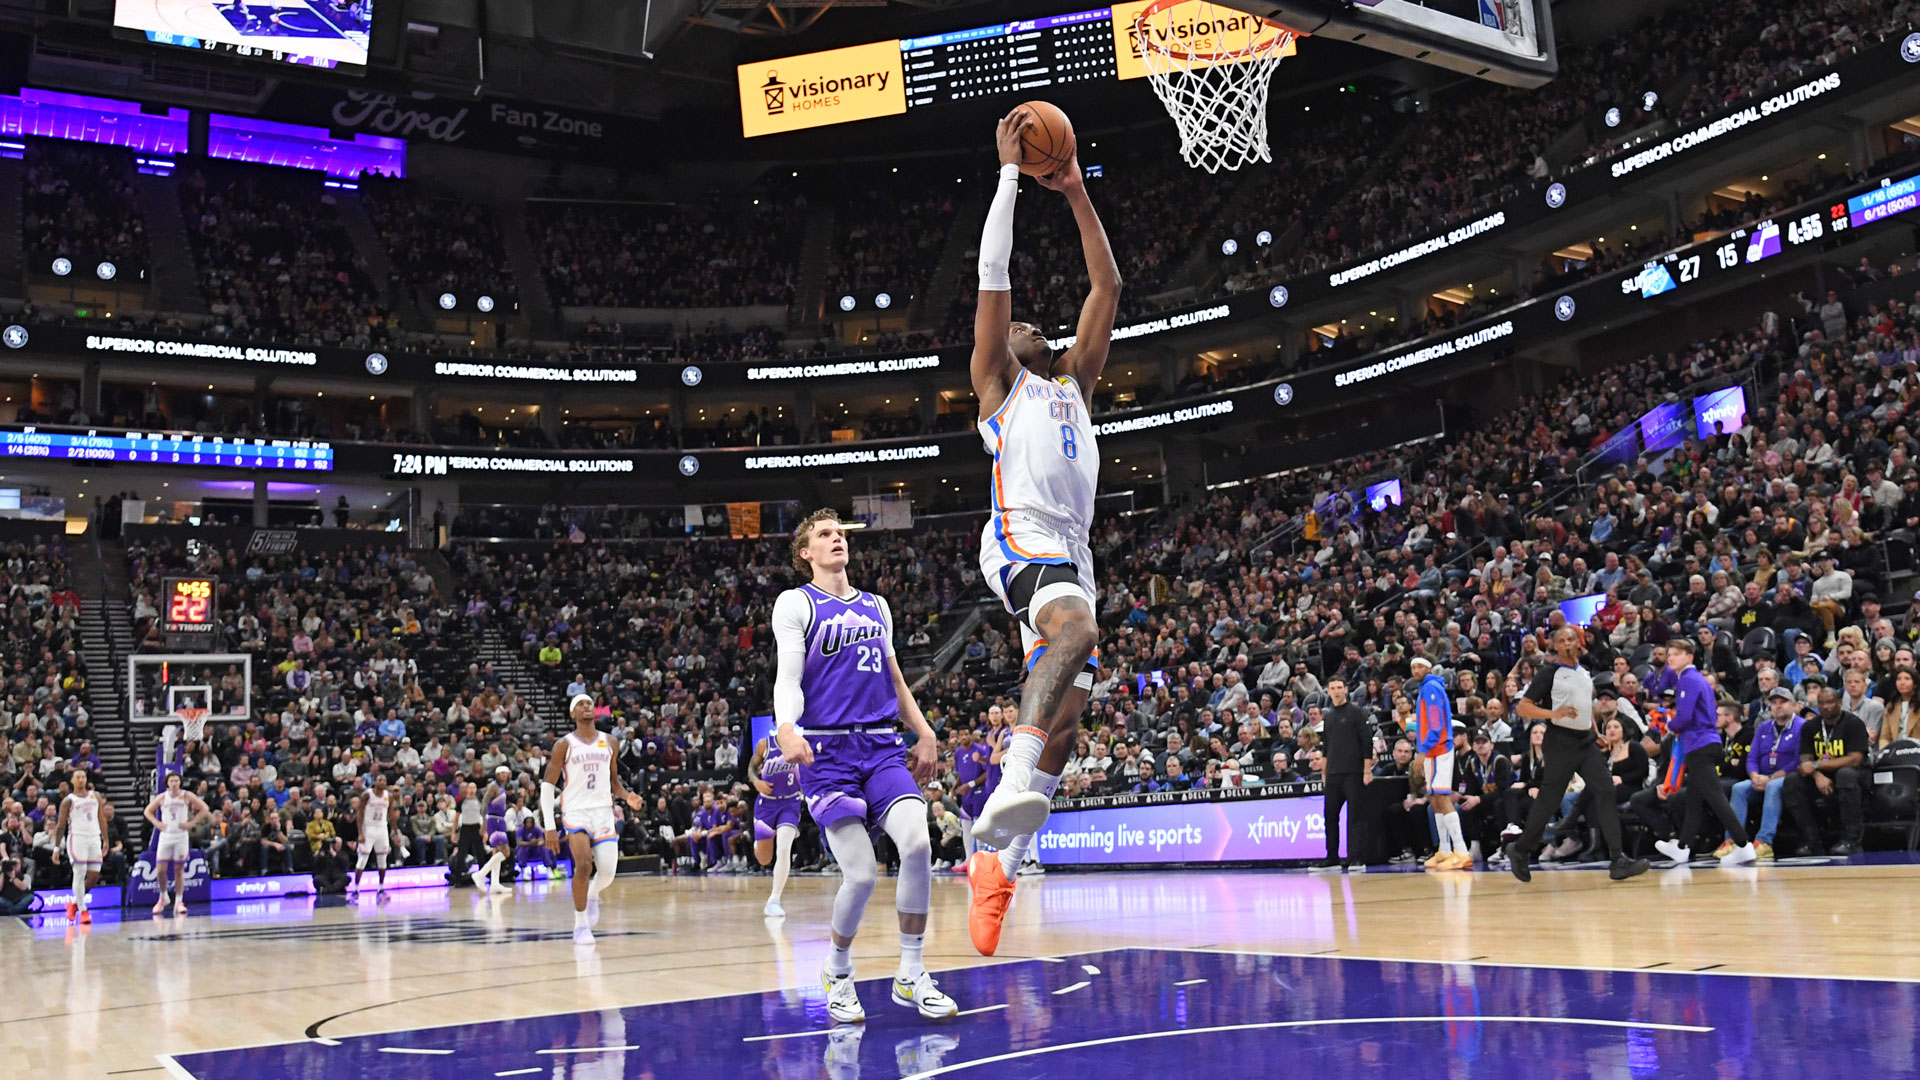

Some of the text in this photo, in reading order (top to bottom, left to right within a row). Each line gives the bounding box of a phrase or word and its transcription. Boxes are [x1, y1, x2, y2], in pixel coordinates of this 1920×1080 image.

[1156, 14, 1264, 40] visionary
[154, 32, 173, 44] OKC
[204, 40, 216, 51] 27
[1165, 39, 1212, 52] OMES
[788, 70, 890, 98] visionary
[332, 88, 602, 142] Ford Fan Zone
[792, 96, 840, 112] HOMES
[1612, 72, 1840, 178] SUPERIOR COMMERCIAL SOLUTIONS
[1788, 194, 1916, 245] 4:55 1ST 6/12 (50%)
[1830, 203, 1845, 219] 22
[1330, 212, 1505, 287] SUPERIOR COMMERCIAL SOLUTIONS
[1716, 242, 1738, 270] 15
[1678, 255, 1700, 282] 27
[1170, 305, 1230, 328] SOLUTIONS
[86, 336, 316, 366] SUPERIOR COMMERCIAL SOLUTIONS
[1335, 321, 1513, 387] SUPERIOR COMMERCIAL SOLUTIONS
[435, 362, 637, 382] SUPERIOR COMMERCIAL SOLUTIONS
[748, 356, 940, 380] SUPERIOR COMMERCIAL SOLUTIONS
[1101, 410, 1173, 435] COMMERCIAL
[1174, 400, 1233, 426] SOLUTIONS
[1702, 404, 1738, 425] xfinity
[1060, 422, 1079, 462] 8
[256, 457, 263, 466] 4
[393, 454, 422, 473] 7:24
[425, 456, 447, 474] PM
[490, 458, 568, 471] COMMERCIAL
[568, 459, 633, 472] SOLUTIONS
[745, 445, 940, 470] SUPERIOR COMMERCIAL SOLUTIONS
[252, 533, 266, 551] 5
[177, 581, 211, 598] 4:55
[171, 594, 207, 623] 22
[179, 624, 214, 632] TISSOT
[820, 623, 882, 657] UTAH
[857, 645, 882, 673] 23
[1814, 739, 1844, 757] UTAH
[583, 763, 599, 772] CITY
[766, 761, 797, 776] UTAH
[587, 774, 596, 790] 2
[787, 773, 795, 786] 3
[1086, 798, 1105, 807] DELTA
[1152, 794, 1174, 802] DELTA
[1188, 791, 1211, 800] DELTA
[1227, 788, 1251, 797] DELTA
[1267, 785, 1294, 795] DELTA
[1040, 824, 1114, 854] streaming
[1118, 823, 1144, 847] live
[1148, 823, 1202, 852] sports
[1248, 813, 1300, 844] xfinity
